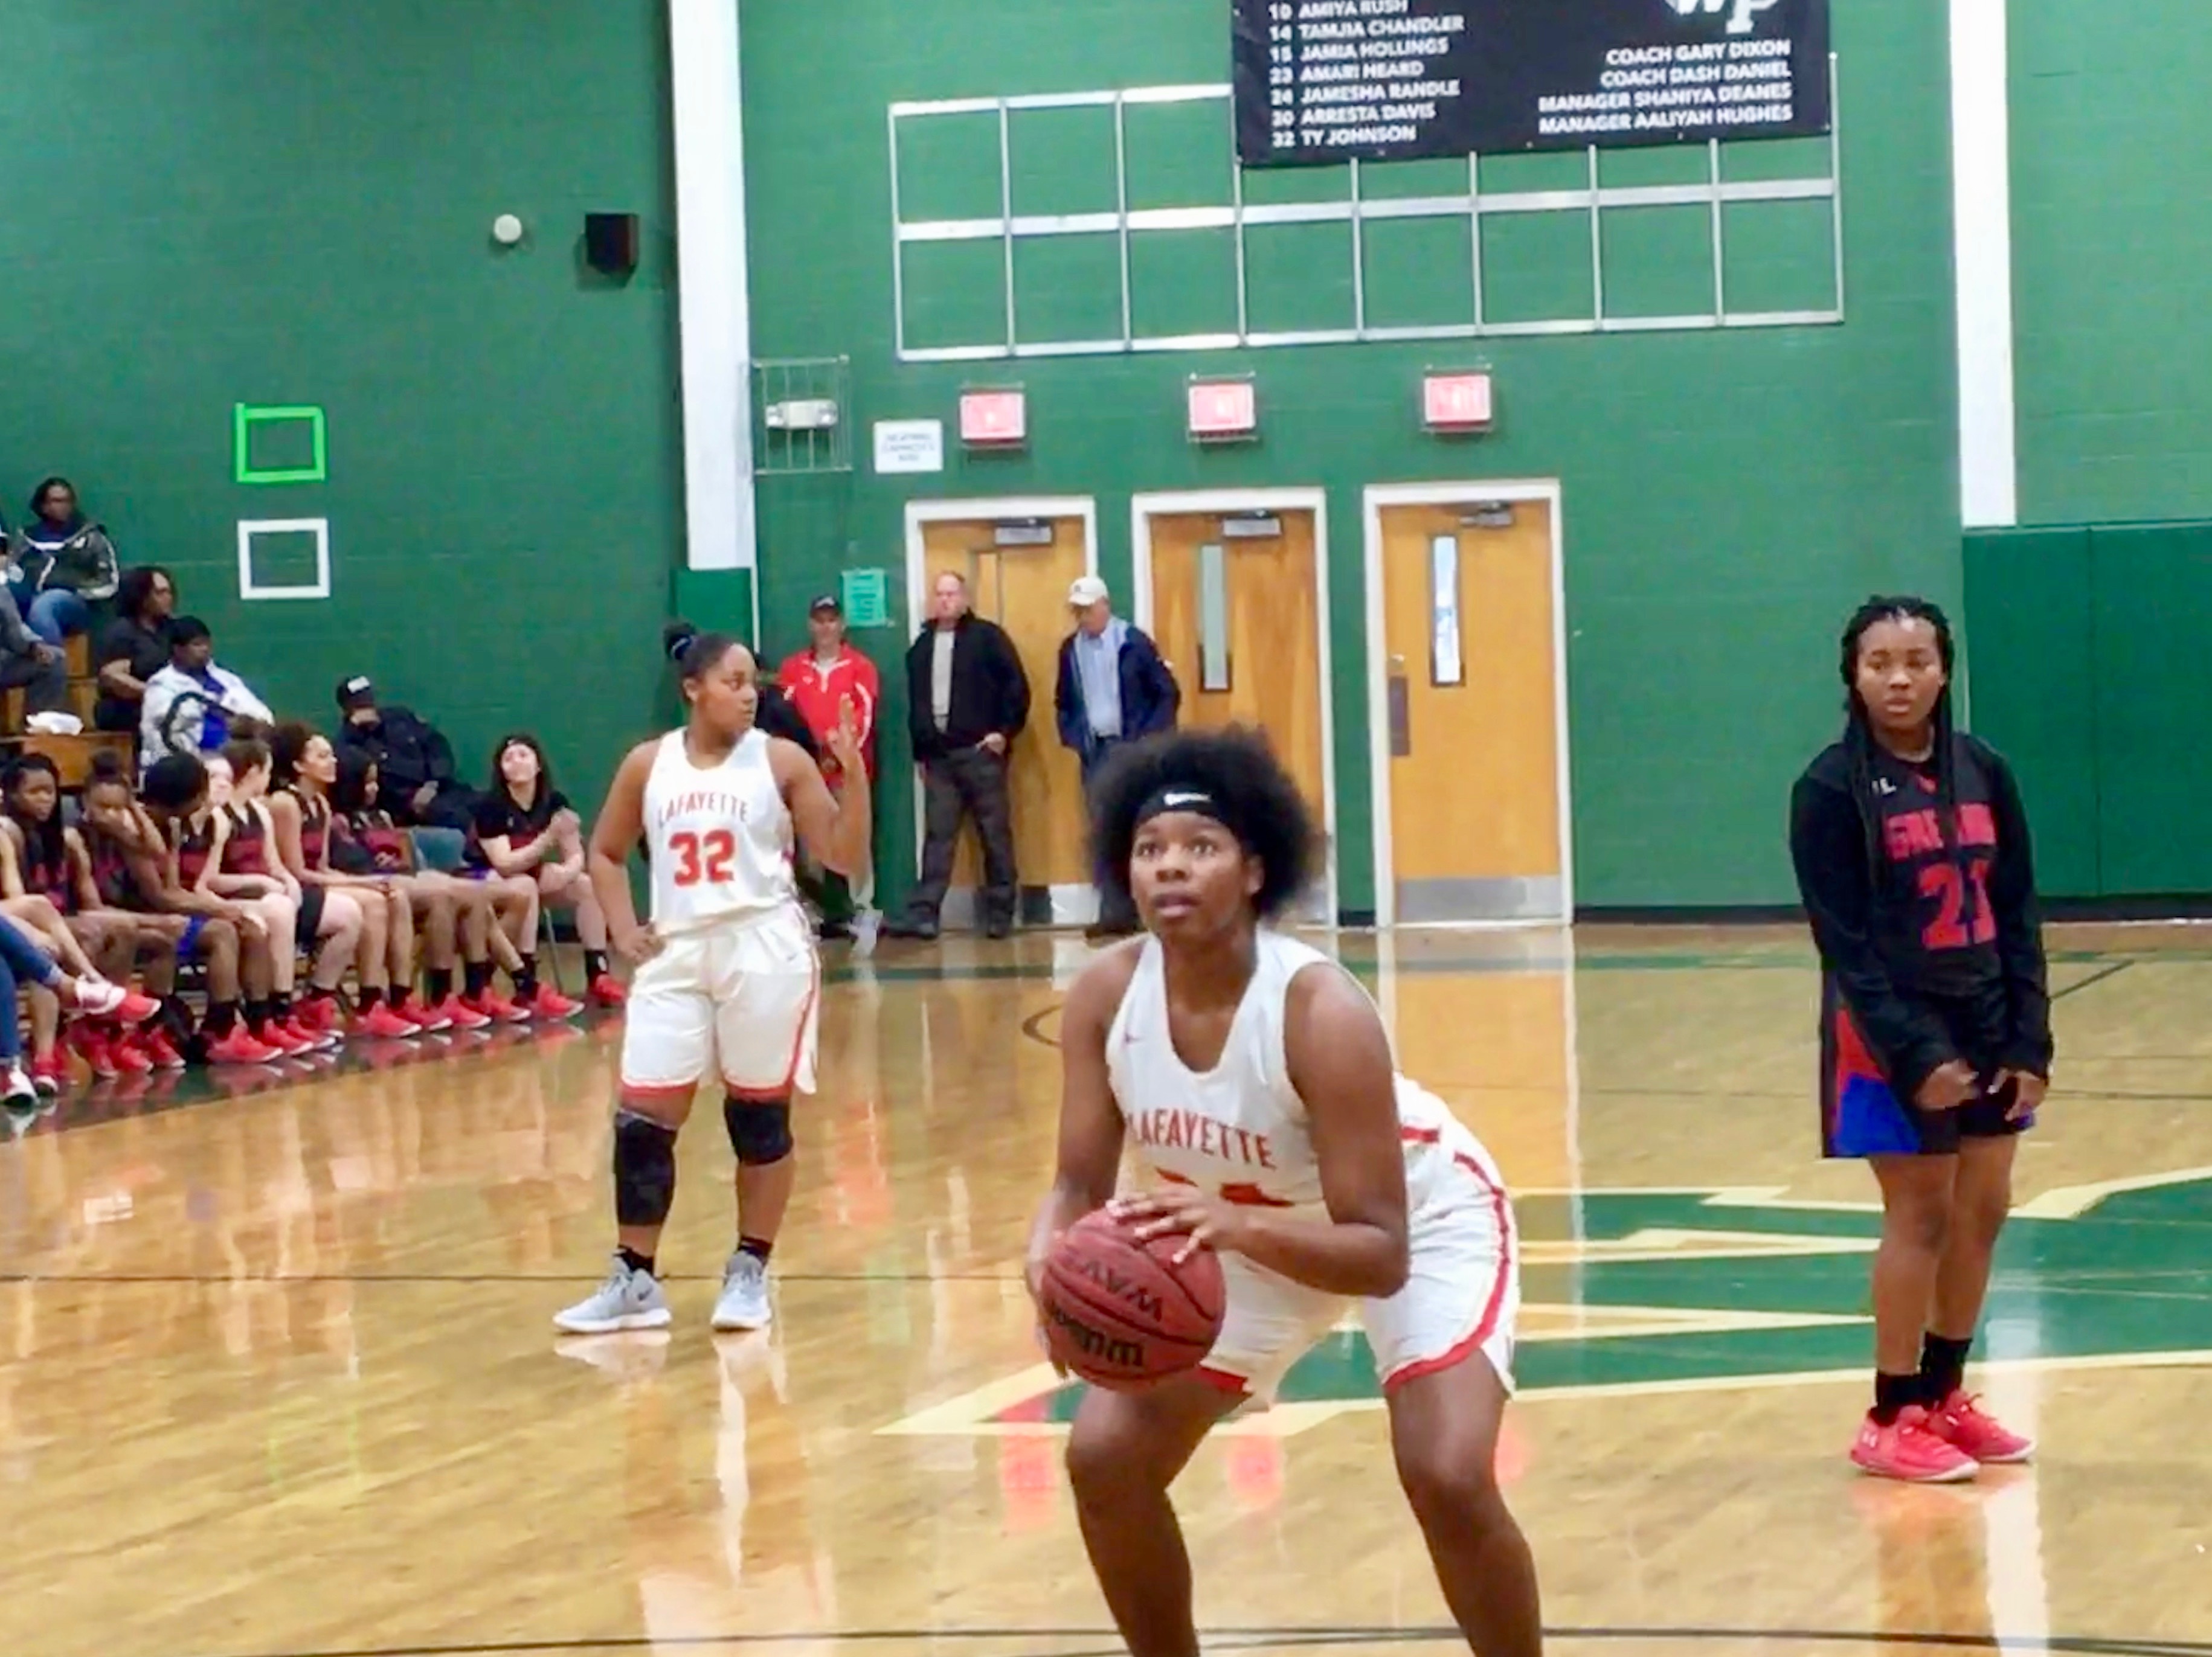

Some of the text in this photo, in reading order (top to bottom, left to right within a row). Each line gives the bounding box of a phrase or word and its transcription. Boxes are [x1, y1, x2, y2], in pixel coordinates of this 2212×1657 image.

[1269, 4, 1292, 20] 10
[1360, 0, 1407, 14] RUSH
[1368, 16, 1464, 34] CHANDLER
[1360, 37, 1448, 57] HOLLINGS
[1606, 39, 1790, 65] COACH GARY DIXON
[1270, 67, 1293, 85] 23
[1363, 60, 1424, 78] HEARD
[1600, 60, 1792, 87] COACH DASH DANIEL
[1389, 80, 1459, 98] RANDLE
[1381, 102, 1435, 120] DAVIS
[1538, 92, 1631, 112] MANAGER
[1539, 104, 1793, 133] MANAGER AALIYAH HUGHES
[1273, 125, 1416, 147] 32 TY JOHNSON
[659, 793, 747, 828] LAFAYETTE
[669, 829, 735, 886] 32
